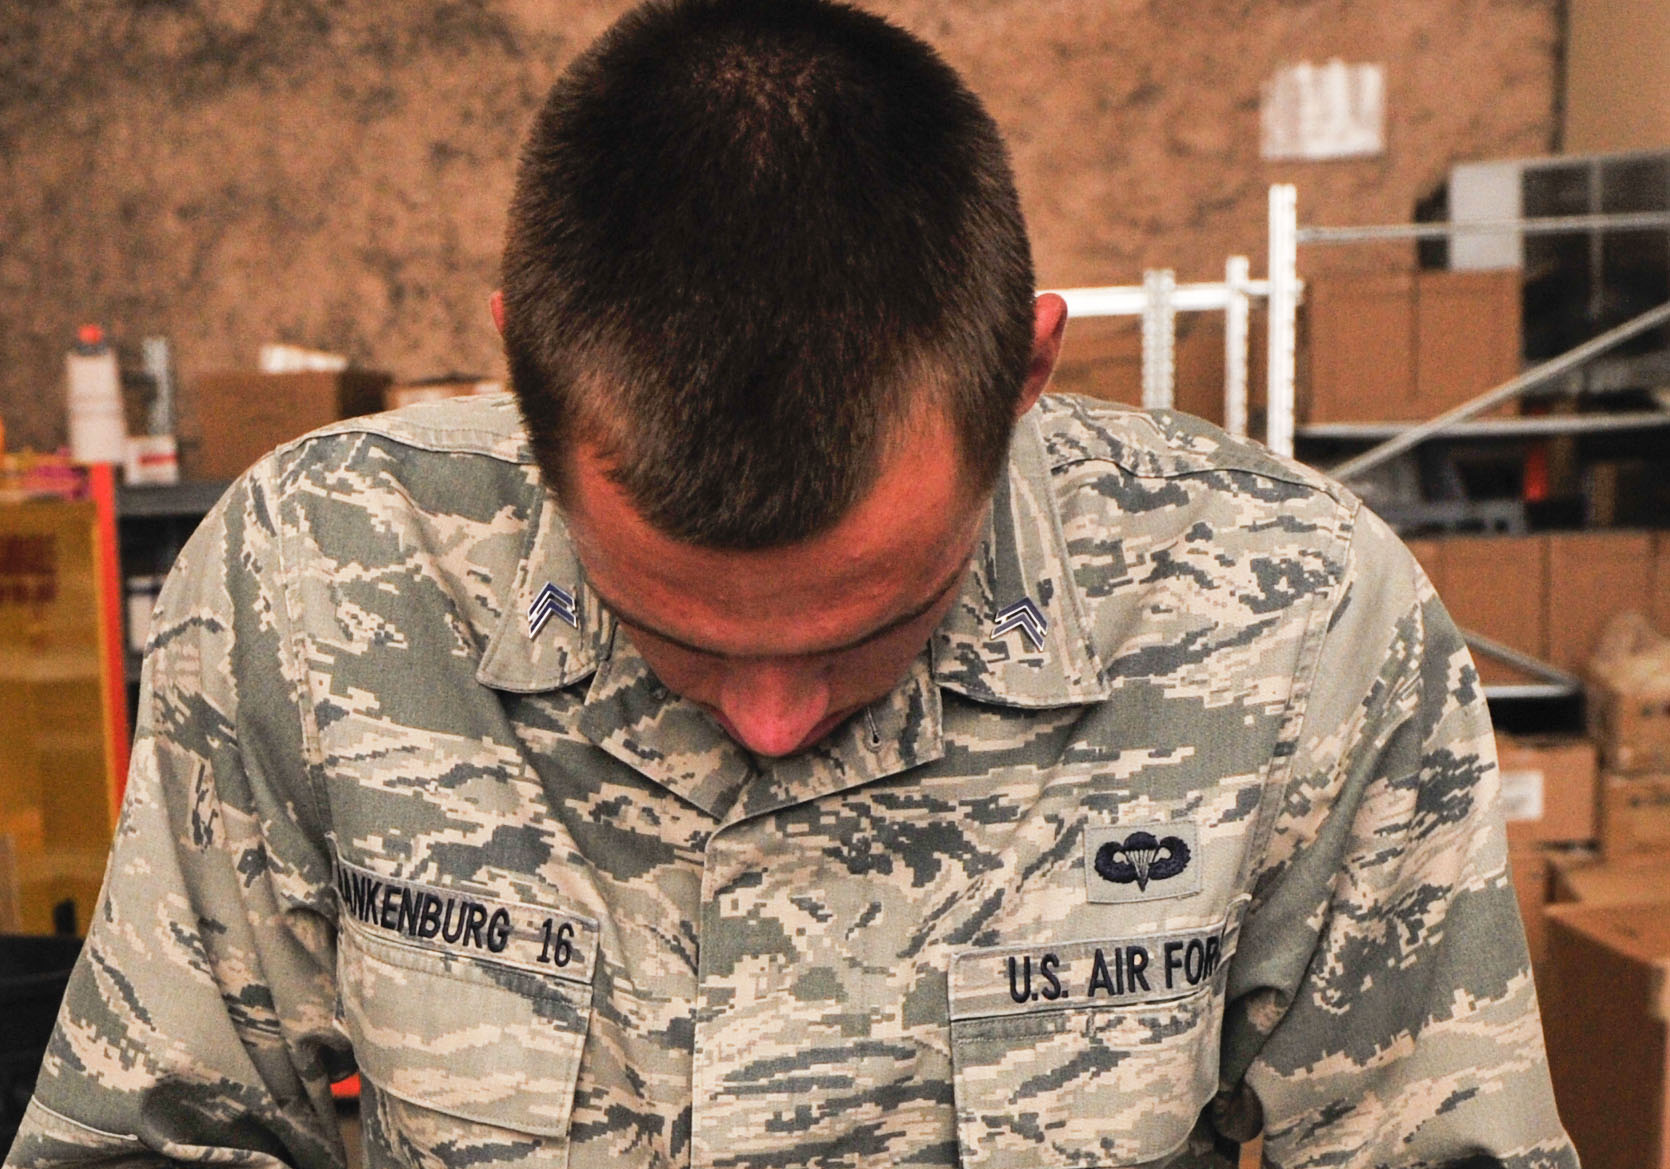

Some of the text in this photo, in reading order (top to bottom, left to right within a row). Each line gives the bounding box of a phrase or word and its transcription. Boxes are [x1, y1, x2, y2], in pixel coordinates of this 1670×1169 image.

[537, 917, 575, 967] 16
[1008, 953, 1069, 1003] U.S.
[1088, 945, 1151, 997] AIR
